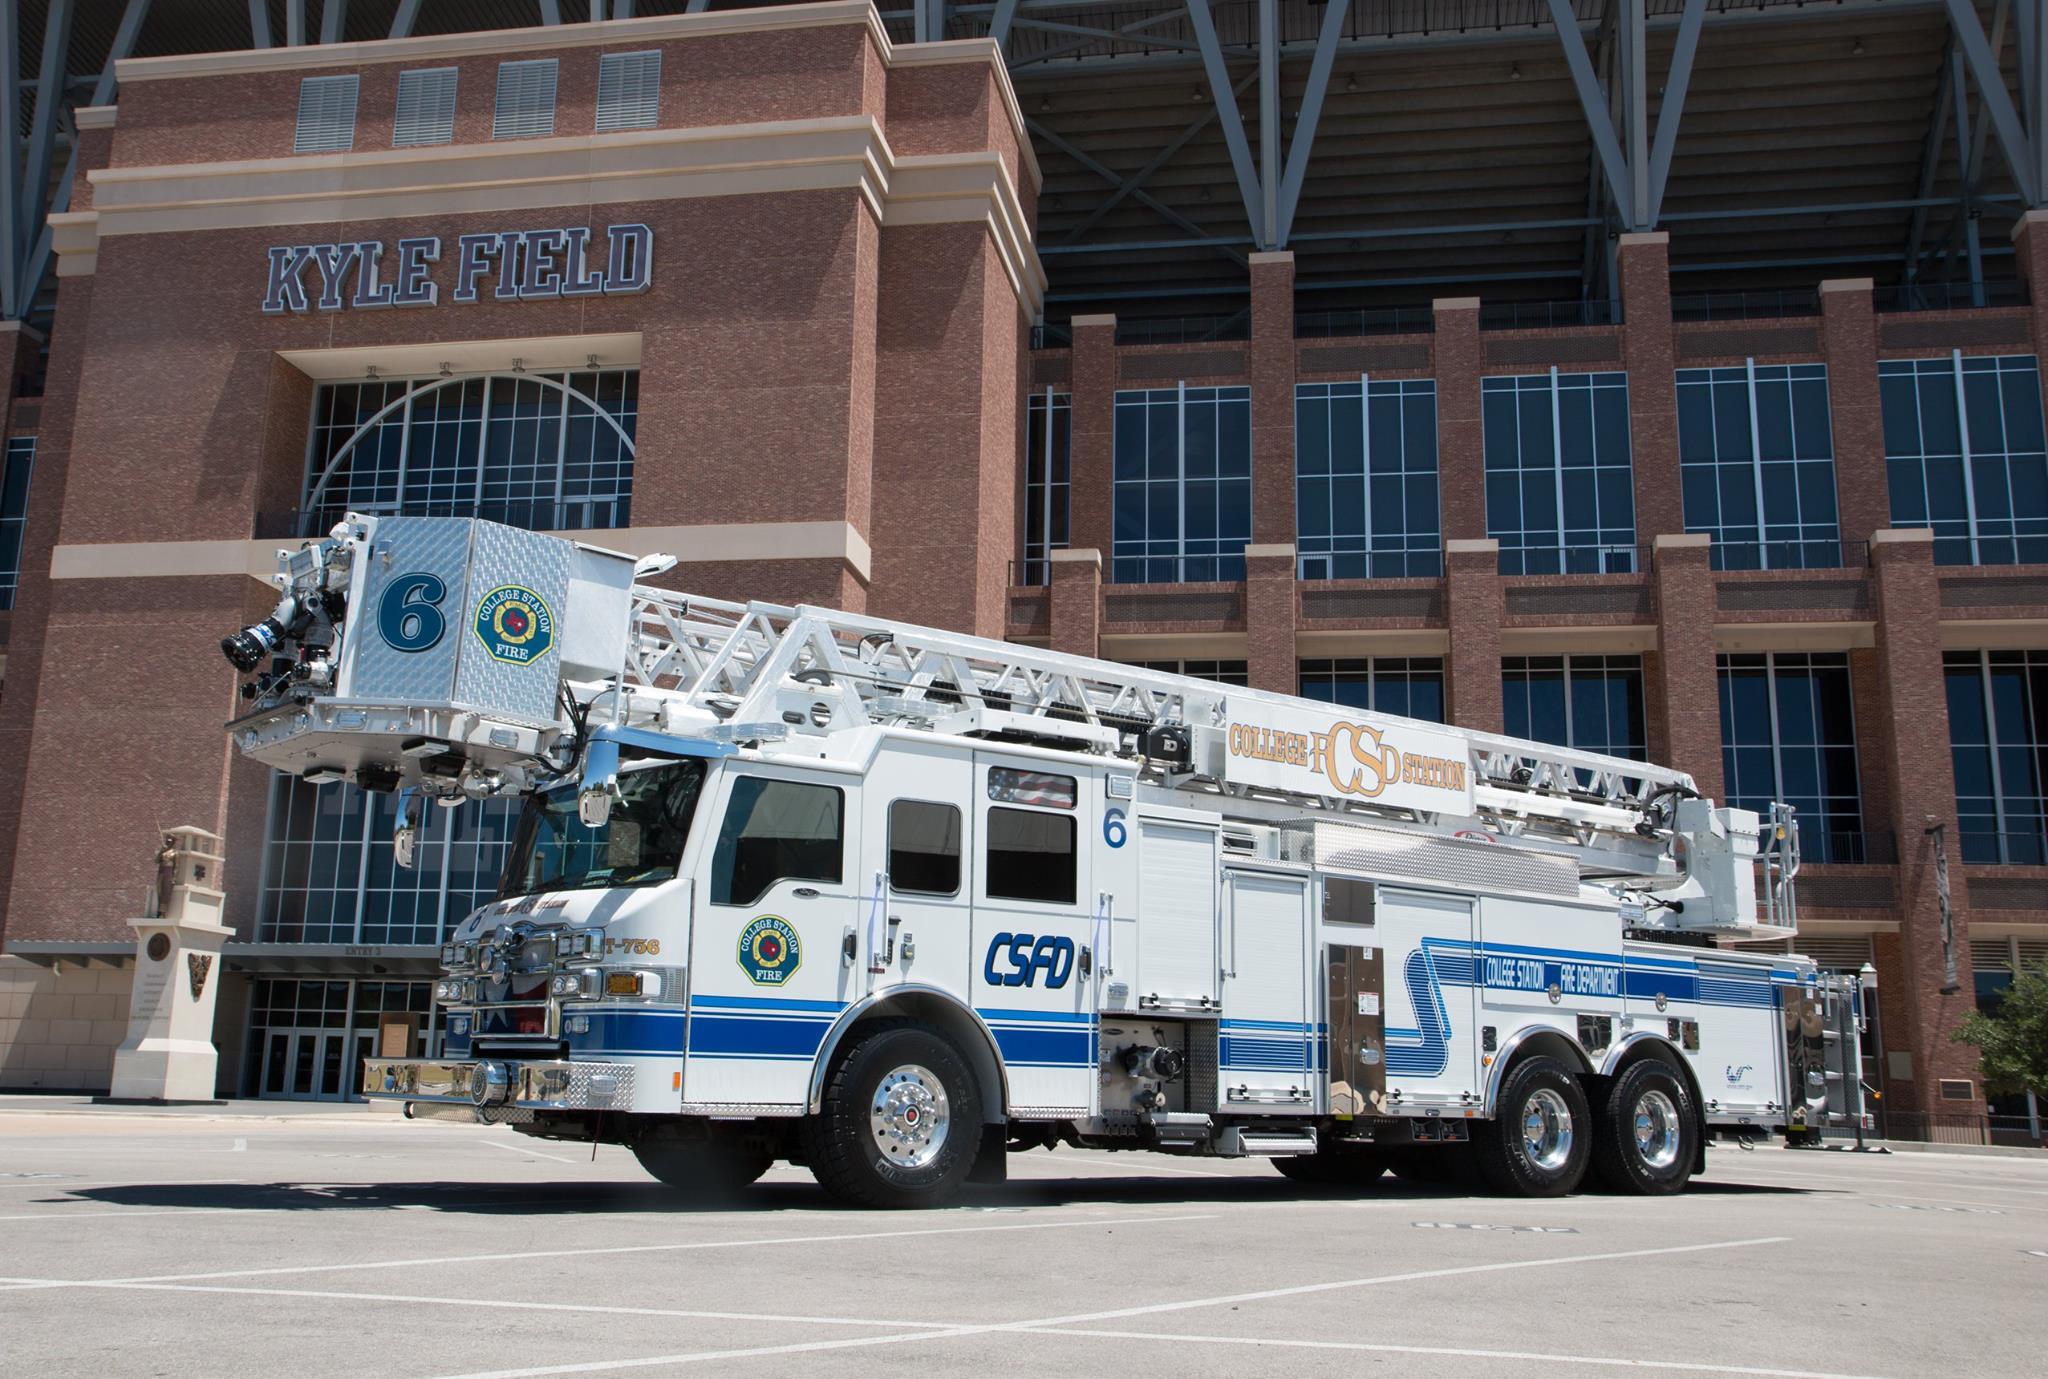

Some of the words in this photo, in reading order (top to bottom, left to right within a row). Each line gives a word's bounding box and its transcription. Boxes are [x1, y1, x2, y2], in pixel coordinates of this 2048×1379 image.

[262, 237, 441, 316] KYLE
[454, 223, 653, 303] FIELD
[377, 572, 447, 653] 6
[480, 589, 520, 621] COLLEGE
[522, 592, 551, 634] STATION
[495, 643, 529, 660] FIRE
[1229, 722, 1308, 767] COLLEGE
[1402, 752, 1466, 792] STATION
[1103, 807, 1127, 849] 6
[605, 938, 661, 956] T-756
[741, 919, 772, 952] COLLEGE
[773, 919, 799, 954] STATION
[755, 969, 783, 981] FIRE
[984, 932, 1075, 989] CSFD
[1487, 957, 1515, 987] COLLEGE
[1517, 961, 1545, 989] STATION
[1560, 964, 1575, 992] FIRE
[1577, 965, 1619, 995] DEPARTMENT
